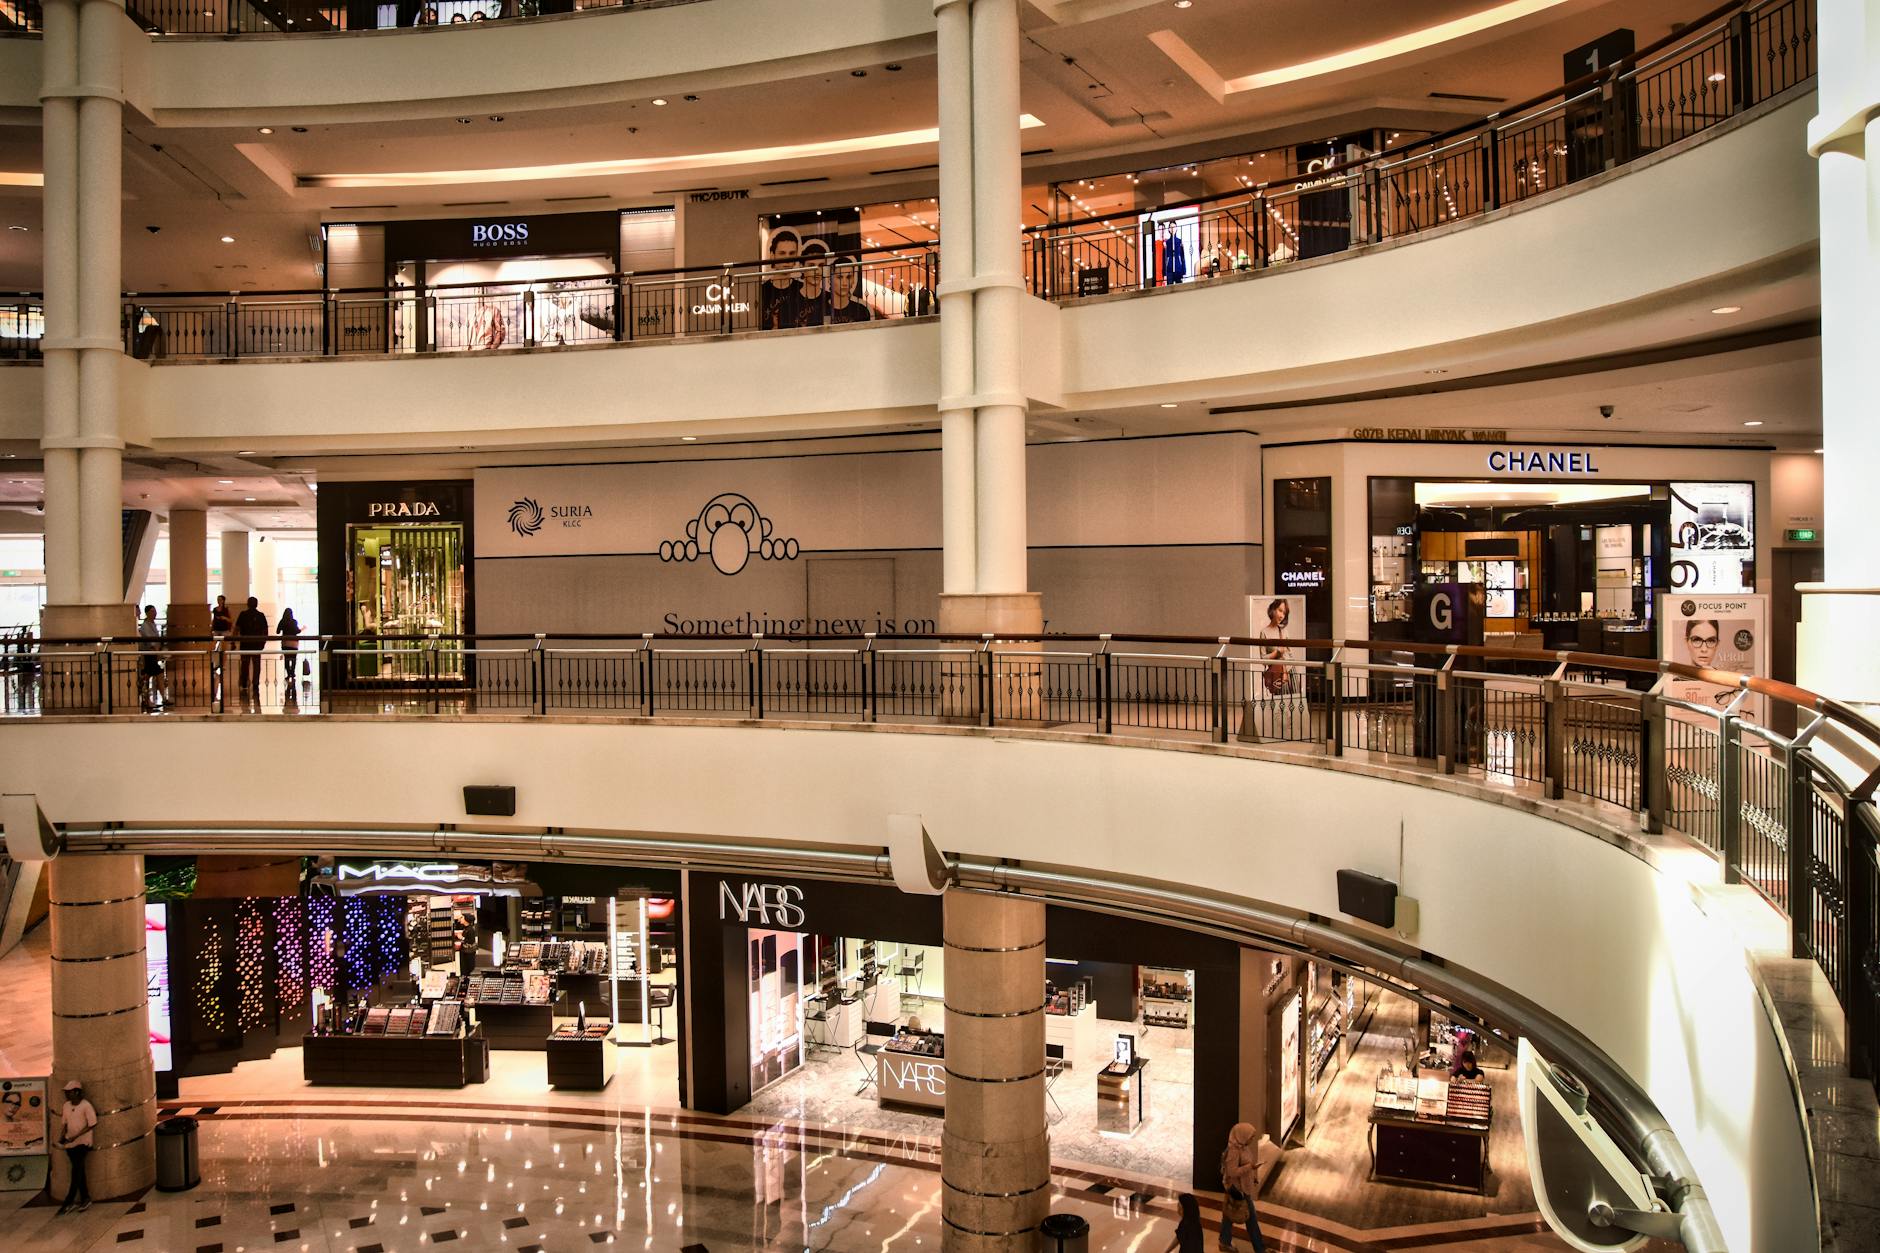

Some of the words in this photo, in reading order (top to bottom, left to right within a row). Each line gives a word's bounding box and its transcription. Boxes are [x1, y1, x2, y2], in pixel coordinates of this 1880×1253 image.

[1586, 48, 1599, 74] 1
[473, 223, 529, 242] BOSS
[1353, 428, 1384, 440] G07B
[1387, 428, 1422, 441] KEDAI
[1424, 429, 1466, 442] MINYAK
[1487, 451, 1599, 473] CHANEL
[368, 502, 441, 517] PRADA
[551, 505, 593, 518] SURIA
[563, 520, 582, 528] KLCC
[1281, 571, 1326, 581] CHANEL
[1430, 592, 1452, 630] G
[664, 612, 805, 642] Something
[815, 619, 866, 634] new
[875, 611, 897, 634] is
[904, 618, 936, 634] on
[719, 880, 805, 928] NARS
[884, 1058, 946, 1096] NARS
